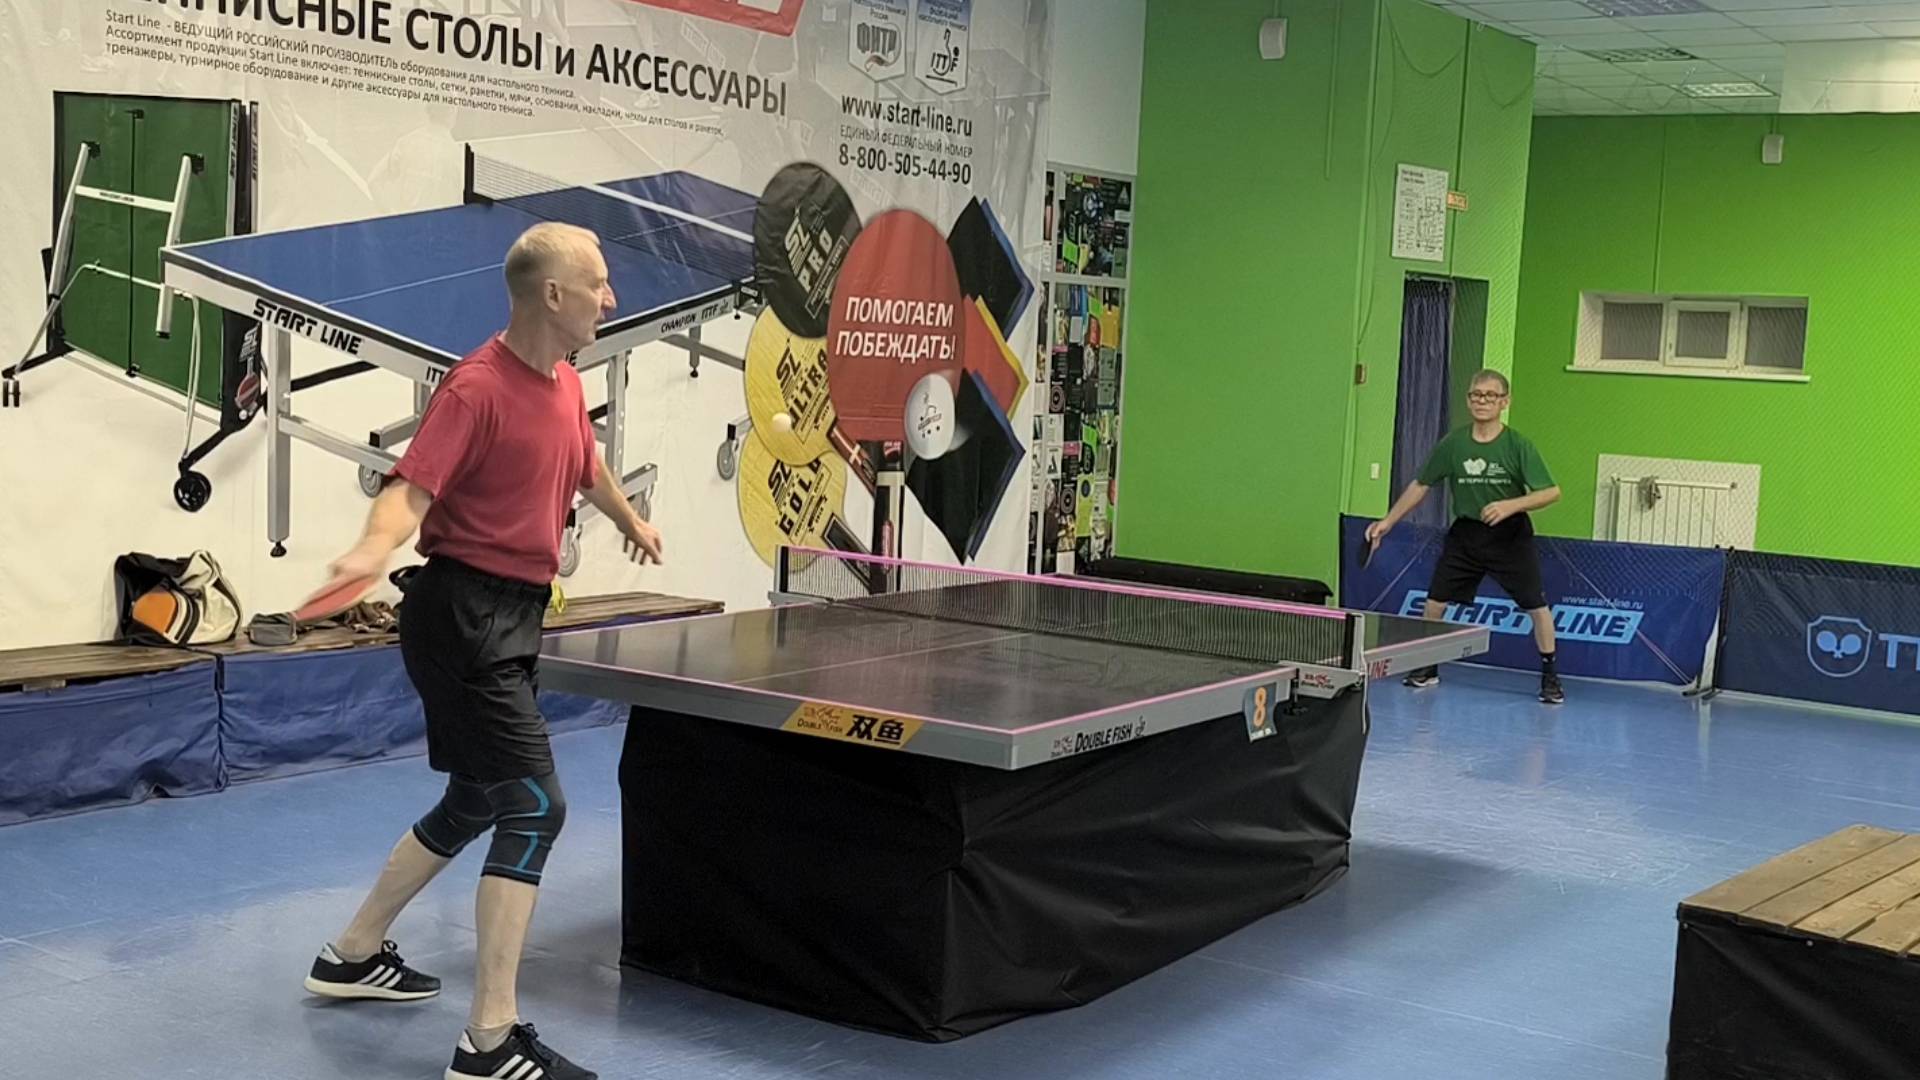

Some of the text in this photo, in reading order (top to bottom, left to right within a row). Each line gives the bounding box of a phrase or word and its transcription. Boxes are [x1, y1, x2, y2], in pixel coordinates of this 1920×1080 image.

[106, 9, 134, 26] Start
[137, 15, 161, 29] Line
[174, 21, 233, 40] ВЕДУЩИЙ
[236, 31, 309, 53] РОССИЙСКИЙ
[311, 44, 398, 69] ПРОИЗВОДИТЕЛЬ
[400, 60, 467, 82] оборудования
[468, 72, 485, 84] для
[487, 75, 539, 94] настольного
[106, 25, 183, 47] Ассортимент
[185, 40, 247, 57] продукции
[250, 50, 275, 63] Start
[277, 51, 298, 66] Line
[301, 57, 351, 75] включает:
[353, 66, 406, 85] теннисные
[408, 75, 439, 92] столы,
[440, 80, 467, 96] сетки,
[405, 9, 542, 70] СТОЛЫ
[555, 45, 575, 77] и
[586, 43, 786, 116] АКСЕССУАРЫ
[106, 42, 176, 64] тренажеры,
[179, 53, 241, 73] турнирное
[242, 61, 319, 84] оборудование
[321, 76, 329, 85] и
[331, 77, 364, 94] другие
[365, 83, 421, 101] аксессуары
[422, 91, 440, 104] для
[442, 93, 497, 112] настольного
[841, 95, 973, 137] www.start-line.ru
[840, 124, 973, 158] ЕДИНЫЙ ФЕДЕРАЛЬНЫЙ НОМЕР
[838, 143, 972, 185] 8-800-505-44-90
[253, 298, 362, 355] START LINE
[845, 296, 954, 328] ПОМОГАЕМ
[835, 331, 956, 364] ПОБЕЖДАТЬ!
[1562, 595, 1644, 610] www.start-line.ru
[1554, 610, 1632, 638] LINE
[1253, 687, 1267, 727] 8
[846, 714, 904, 745] 双鱼
[1074, 722, 1134, 753] DOUBLE FISH
